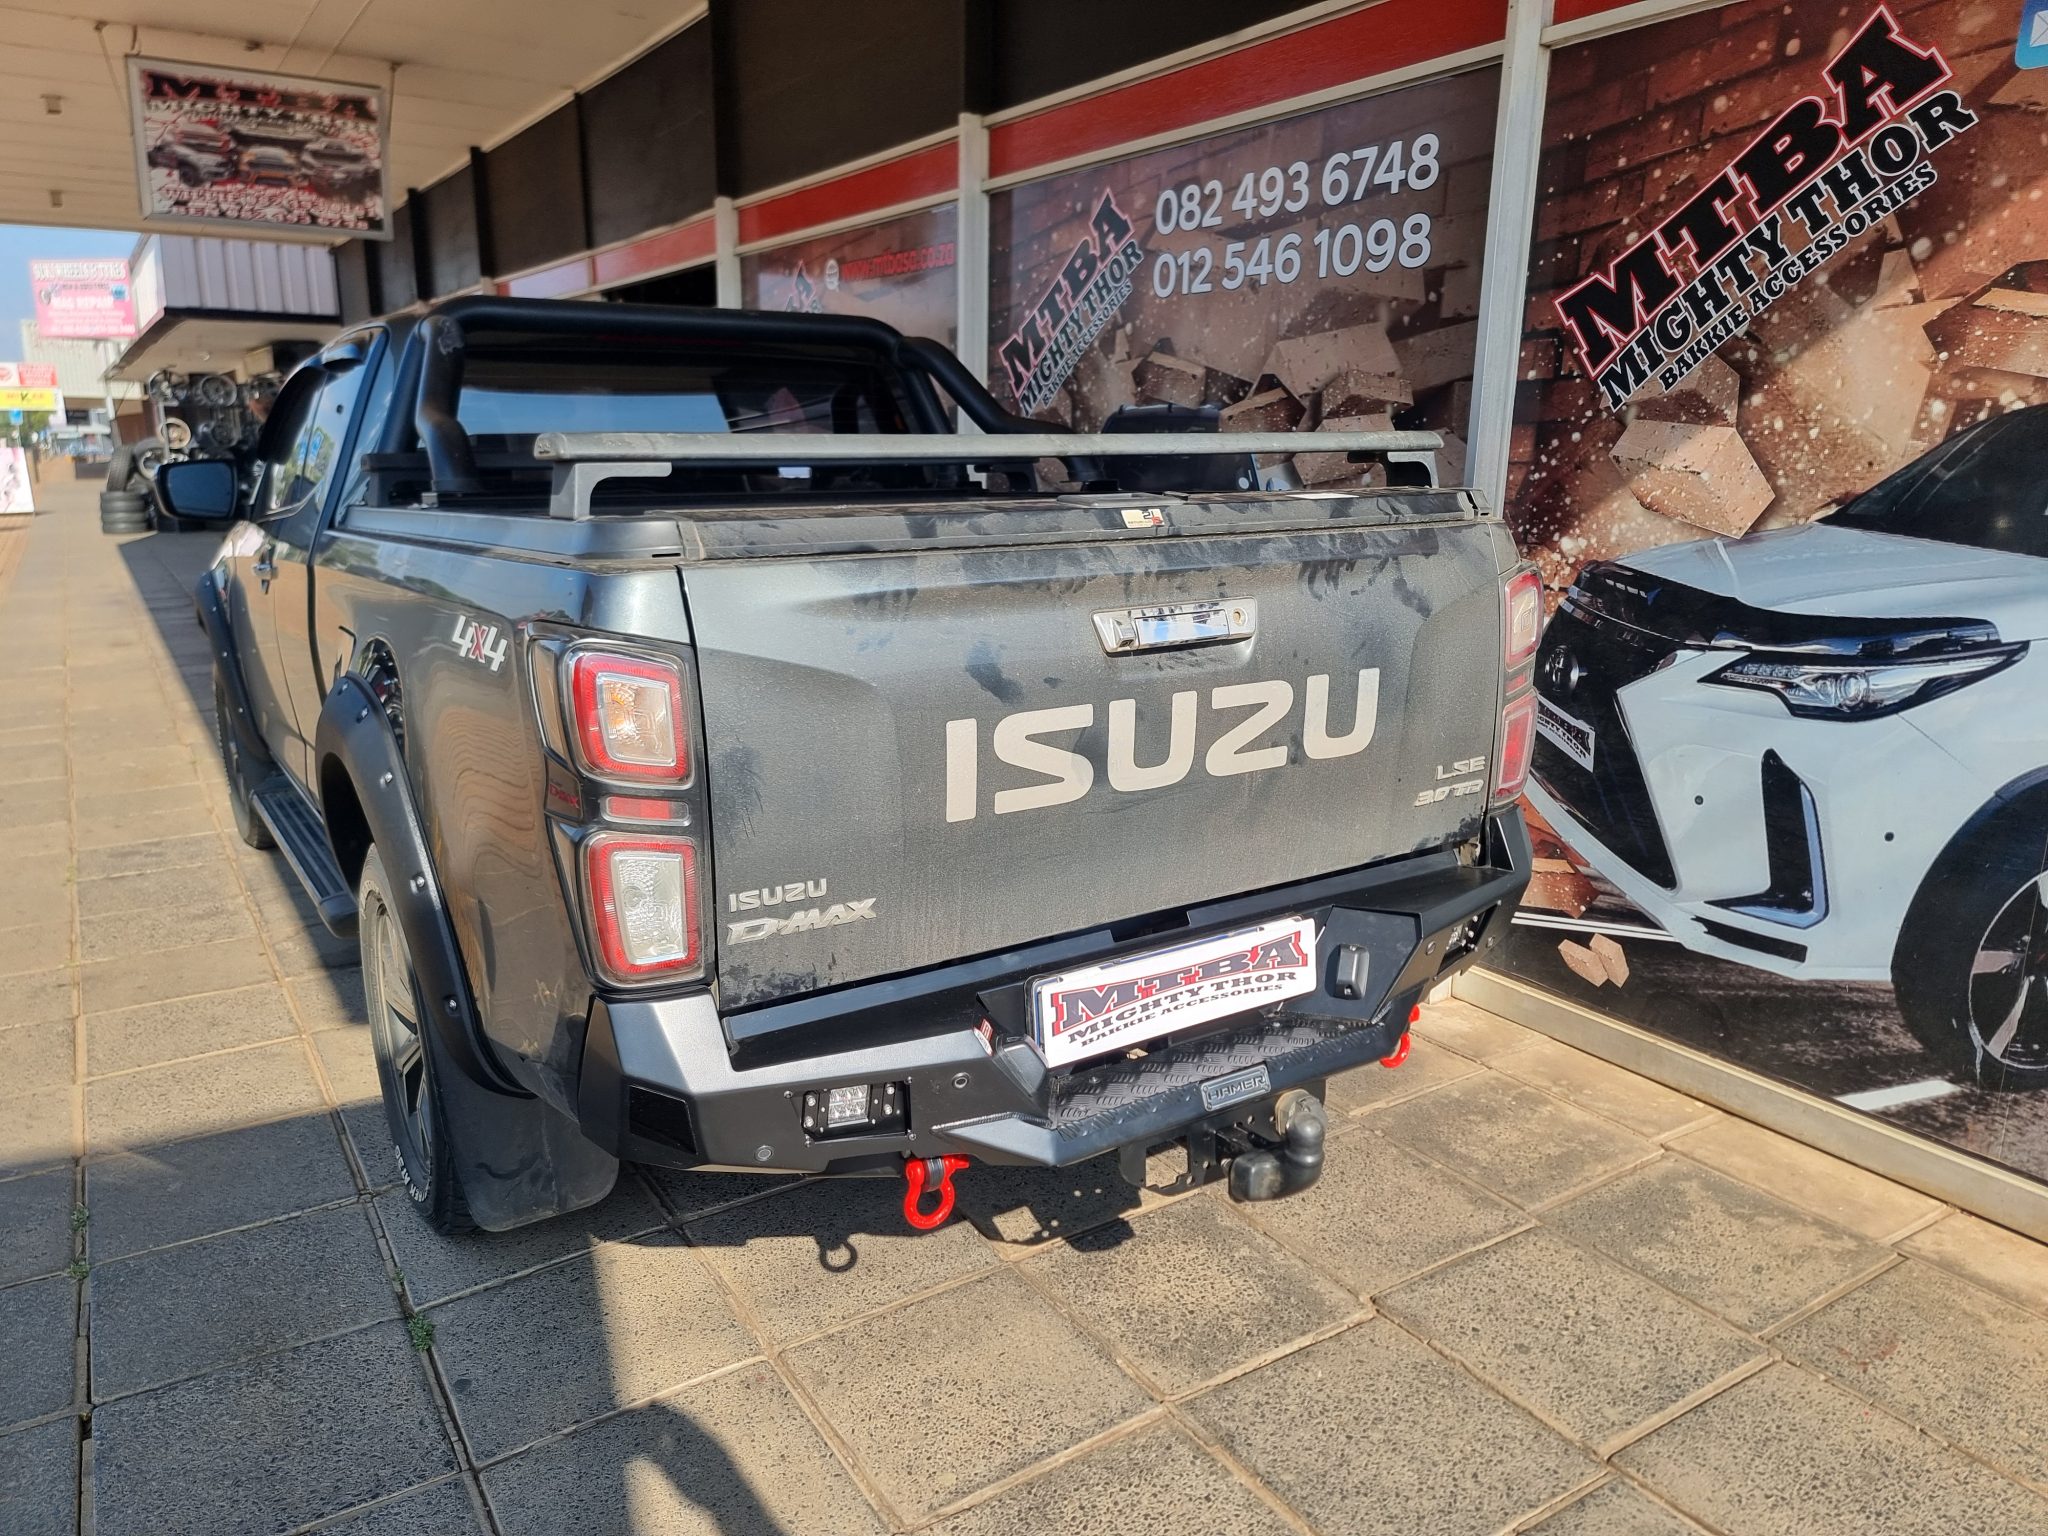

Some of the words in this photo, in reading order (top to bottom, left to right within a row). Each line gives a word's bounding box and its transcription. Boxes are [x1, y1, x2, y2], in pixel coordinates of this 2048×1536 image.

[1155, 179, 1223, 236] 082
[1232, 161, 1309, 220] 493
[1322, 133, 1440, 206] 6748
[1554, 4, 1953, 380] MTBA
[999, 186, 1135, 398] MTBA
[1152, 248, 1213, 298] 012
[1221, 233, 1302, 290] 546
[1314, 213, 1431, 278] 1098
[1597, 212, 1788, 412] MIGHTY
[1784, 90, 1978, 238] THOR
[1657, 302, 1750, 393] BAKKIE
[1747, 162, 1938, 316] ACCESSORIES
[1019, 305, 1085, 417] MIGHTY
[1082, 239, 1145, 322] THOR
[1042, 352, 1076, 408] BAKKIE
[1069, 278, 1133, 362] ACCESSORIES
[945, 667, 1380, 823] ISUZU
[729, 878, 827, 913] ISUZU
[1051, 930, 1308, 1037] MTBA
[1067, 986, 1205, 1044] MIGHTY
[1210, 971, 1298, 991] THOR
[1081, 1014, 1156, 1048] BAKKIE
[1161, 984, 1283, 1016] ACCESSORIES
[1207, 1075, 1266, 1102] HAMER
